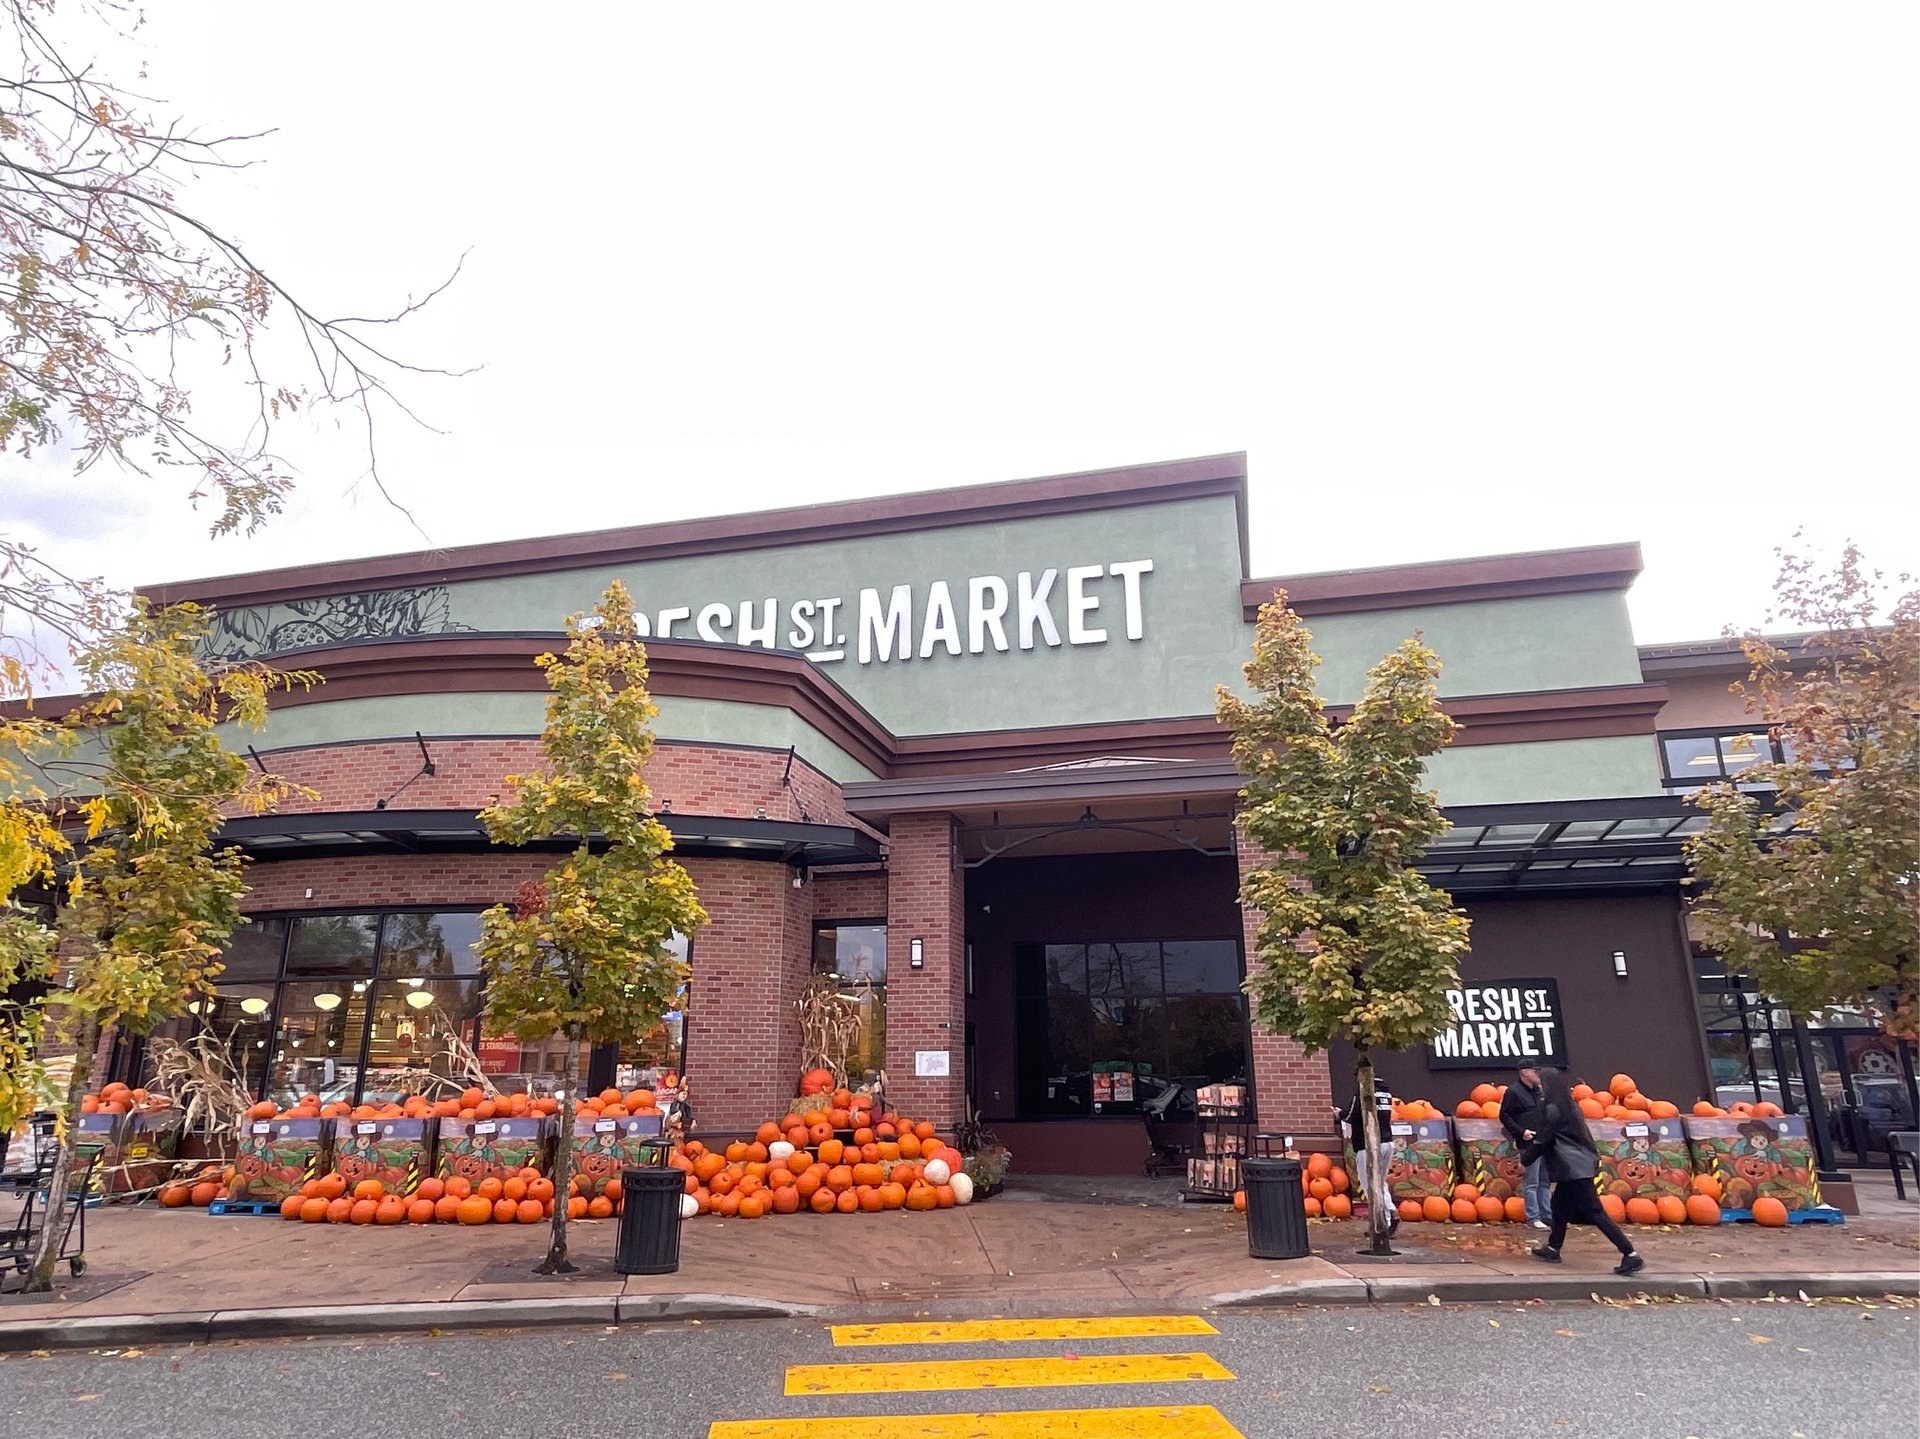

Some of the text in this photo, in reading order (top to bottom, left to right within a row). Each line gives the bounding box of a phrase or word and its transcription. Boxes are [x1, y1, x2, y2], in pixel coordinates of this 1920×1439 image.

[788, 597, 847, 649] ST.
[857, 559, 1155, 665] MARKET
[1444, 987, 1552, 1022] RESH ST.
[1434, 1021, 1555, 1058] MARKET
